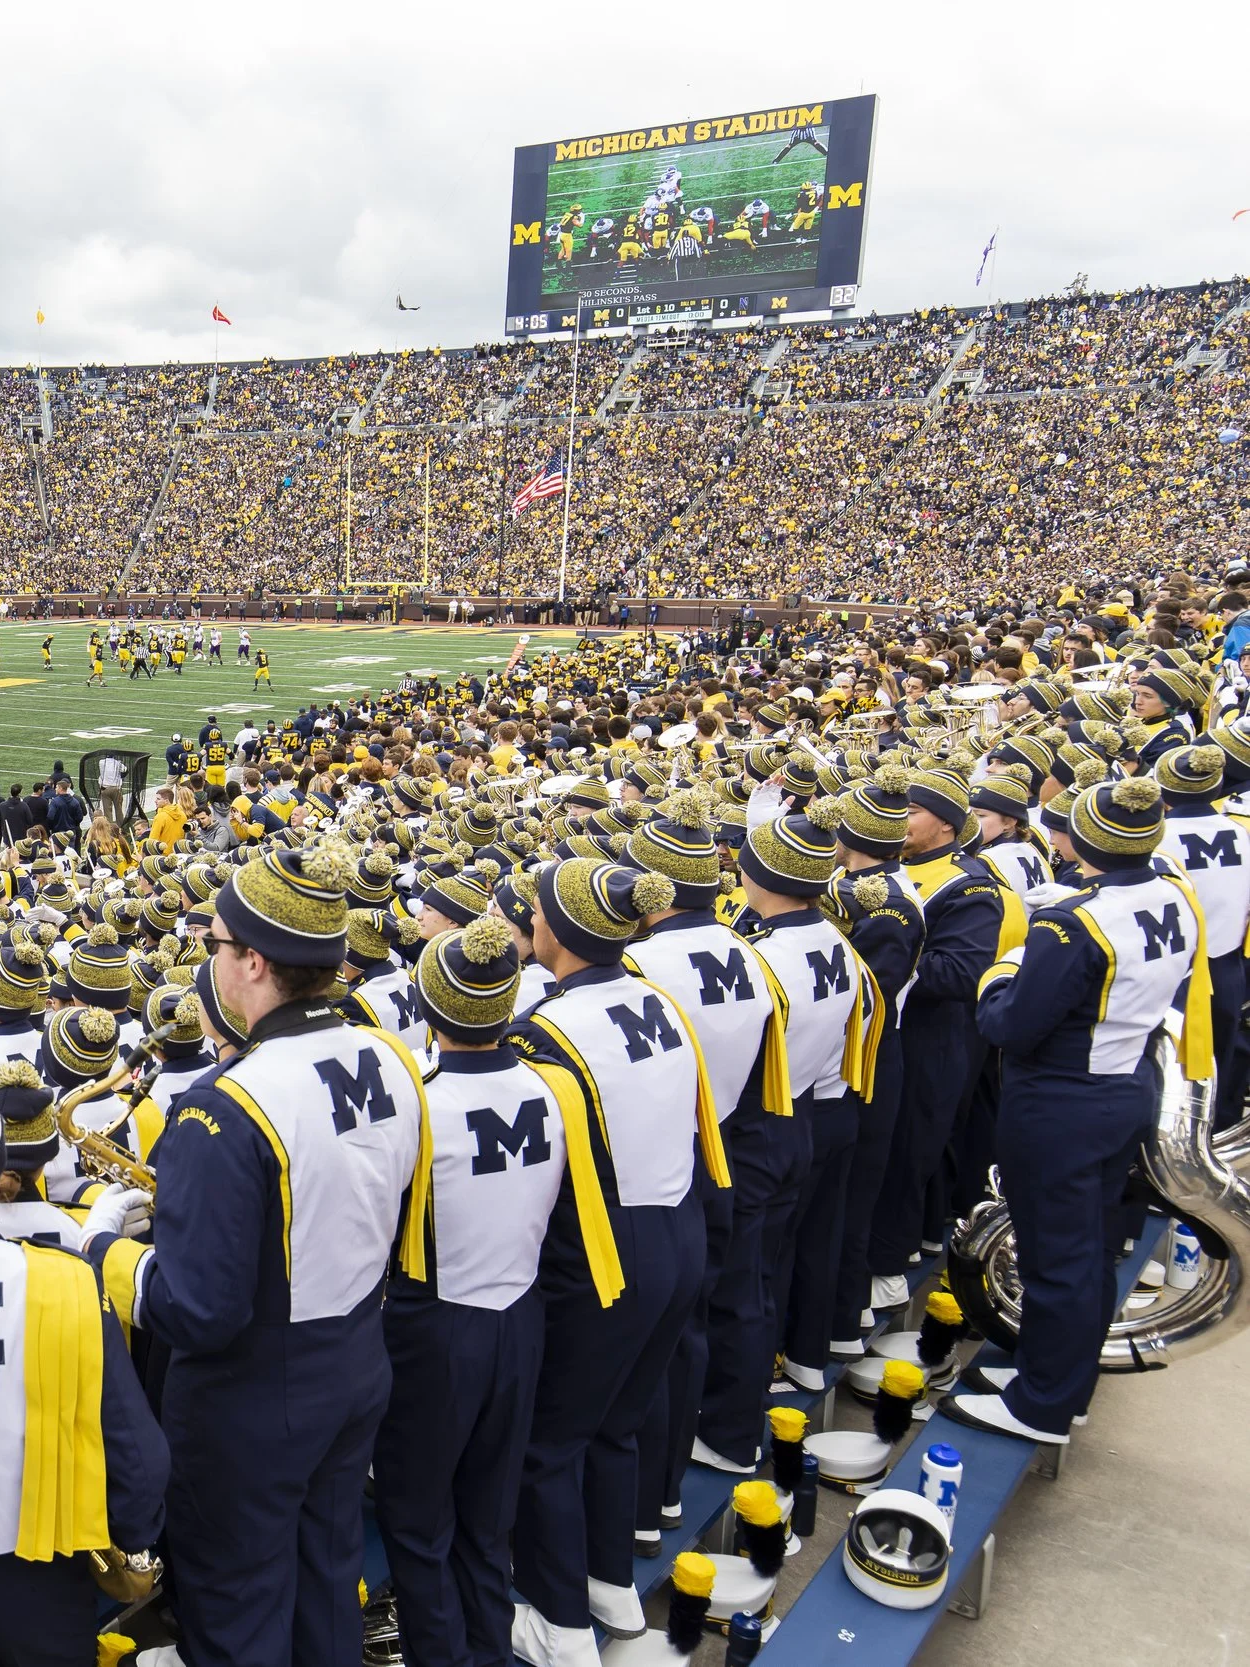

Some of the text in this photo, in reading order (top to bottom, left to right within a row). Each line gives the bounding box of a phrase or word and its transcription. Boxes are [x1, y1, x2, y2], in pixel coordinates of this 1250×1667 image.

[555, 105, 824, 161] MICHIGAN STADIUM
[827, 182, 863, 209] M
[513, 222, 541, 246] M
[623, 224, 635, 237] 12
[581, 294, 657, 307] HILINSKI'S PASS
[594, 286, 642, 297] SECONDS.
[833, 287, 855, 304] 32
[664, 304, 675, 312] 10
[720, 299, 729, 309] 0
[771, 297, 788, 309] M
[562, 315, 576, 327] M
[594, 309, 610, 321] M
[616, 308, 624, 318] 0
[282, 736, 298, 749] 74
[209, 747, 225, 762] 55
[186, 756, 200, 772] 19
[1178, 829, 1243, 871] M
[1017, 856, 1046, 891] M
[964, 886, 1000, 899] MICHIGAN
[513, 901, 525, 914] M
[721, 900, 741, 918] M
[869, 908, 909, 926] MICHIGAN
[1031, 920, 1071, 945] MICHIGAN
[1133, 902, 1186, 962] M
[688, 947, 756, 1005] M
[805, 942, 850, 1003] M
[388, 984, 424, 1032] M
[605, 994, 683, 1063] M
[313, 1047, 397, 1136] M
[177, 1106, 222, 1136] MICHIGAN
[465, 1097, 552, 1176] M
[1174, 1242, 1201, 1265] M
[865, 1558, 921, 1582] MICHIGAN
